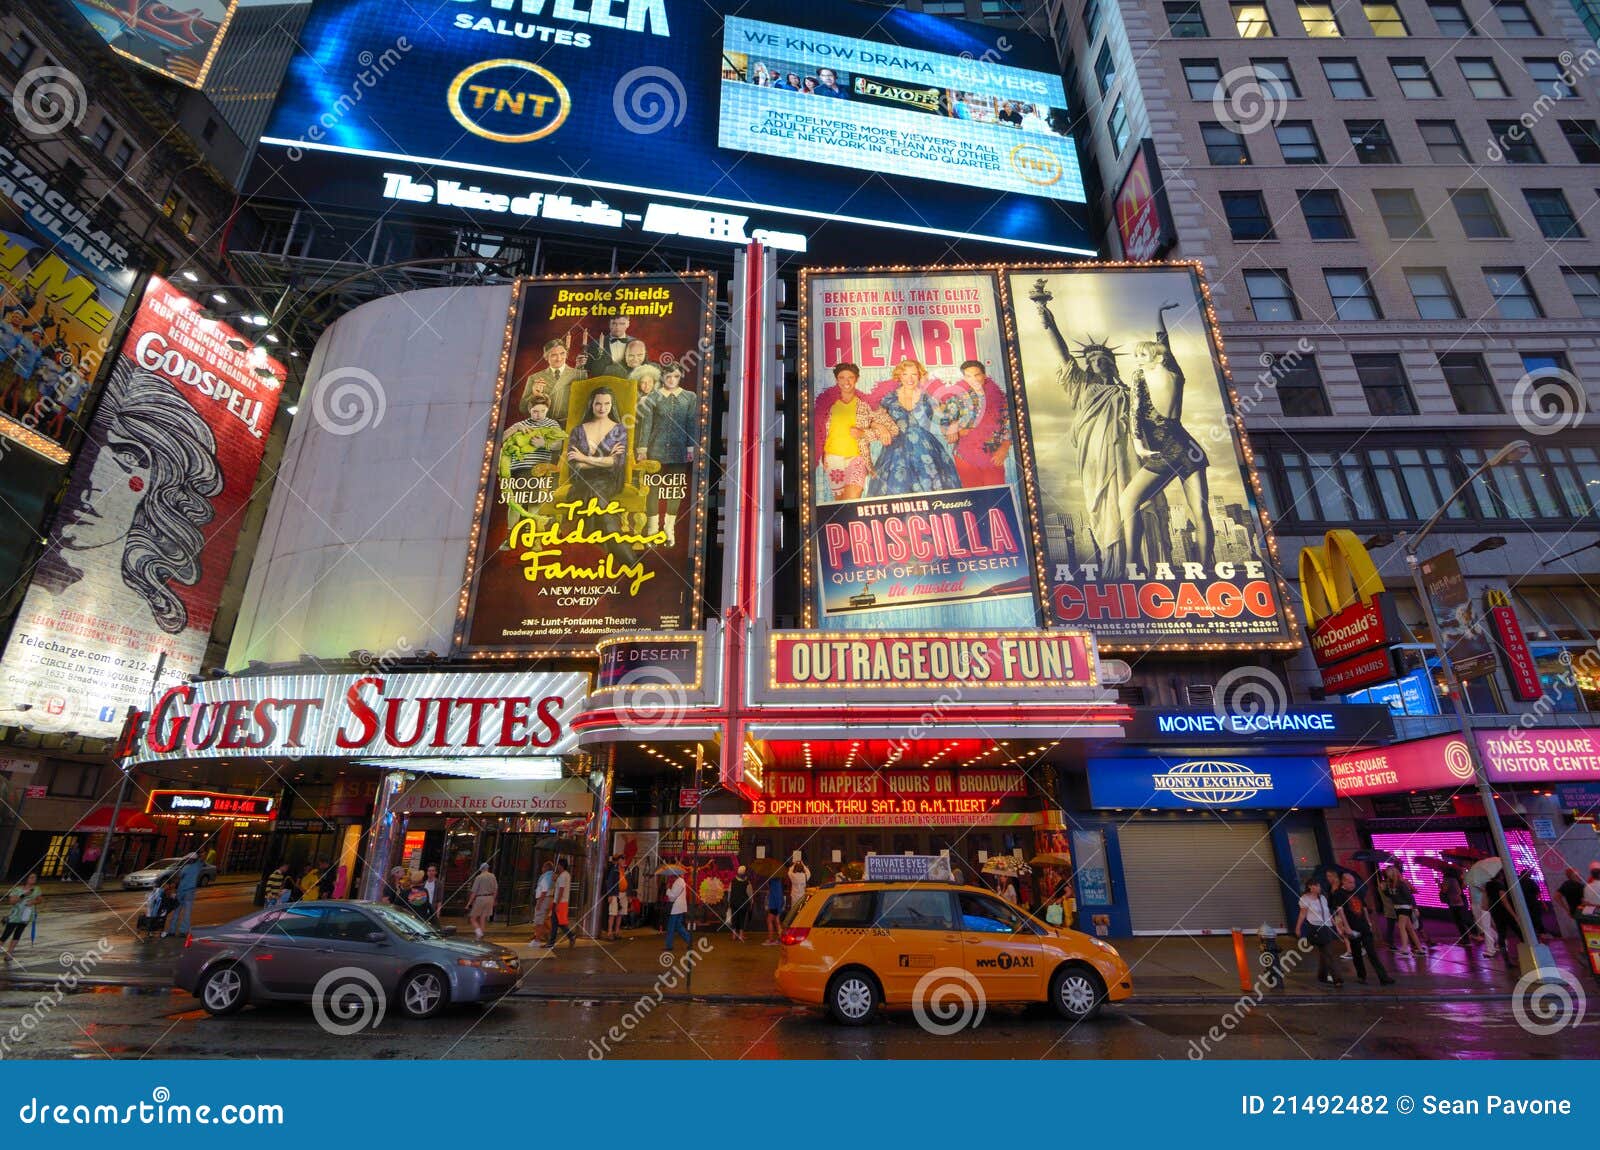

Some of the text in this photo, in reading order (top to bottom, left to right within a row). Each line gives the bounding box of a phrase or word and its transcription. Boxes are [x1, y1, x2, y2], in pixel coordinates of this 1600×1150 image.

[454, 13, 592, 48] SALUTES
[744, 30, 1049, 95] WE KNOW DRAMA DELIVERS
[469, 85, 554, 118] TNT
[867, 83, 940, 105] PLAYOFFS
[764, 118, 1000, 163] ADULT KEY DEMOS THAN ANY OTHER
[767, 110, 998, 155] TNT DELIVERS MORE VIEWERS IN ALL
[750, 125, 1001, 172] CABLE NETWORK IN SECOND QUARTER
[1016, 156, 1054, 173] TNT
[383, 173, 434, 203] The
[437, 180, 510, 212] Voice
[510, 191, 545, 216] of
[541, 194, 623, 228] Media
[558, 287, 669, 303] Brooke Shields
[883, 290, 904, 302] ALL
[909, 290, 940, 301] THAT
[944, 289, 979, 301] GLITZ
[550, 302, 673, 320] joins the family!
[825, 304, 981, 317] BEATS A GREAT BIG SEQUINED
[149, 298, 175, 323] FROM
[175, 315, 192, 334] THE
[191, 327, 235, 360] COMPOSER
[168, 326, 206, 358] RETURNS
[206, 350, 217, 365] TO
[136, 331, 263, 439] GODSPELL
[500, 476, 554, 490] BROOKE
[643, 473, 687, 488] ROGER
[498, 490, 555, 504] SHIELDS
[658, 486, 686, 500] REES
[556, 498, 625, 520] The
[857, 499, 973, 517] BETTE MIDLER Presents
[509, 518, 668, 550] Addams
[825, 508, 1018, 569] PRISCILLA
[520, 550, 655, 597] Family
[832, 556, 1019, 585] QUEEN OF THE DESERT
[1054, 560, 1265, 581] AT LARGE
[538, 585, 621, 596] A NEW MUSICAL
[887, 576, 968, 598] the musical
[556, 597, 600, 607] COMEDY
[1053, 581, 1277, 621] CHICAGO
[541, 616, 637, 627] Lunt-Fontanne Theatre
[502, 629, 534, 637] Broadway
[1312, 614, 1378, 650] McDonald's
[1325, 633, 1369, 657] Restaurant
[19, 633, 192, 683] Telecharge.com or 212-29-6200
[603, 649, 690, 664] THE DESERT
[791, 640, 1074, 682] OUTRAGEOUS FUN!
[40, 657, 73, 672] CIRCLE
[75, 664, 85, 674] IN
[88, 667, 105, 678] THE
[1355, 659, 1384, 675] HOURS
[147, 685, 323, 753] GUEST
[336, 677, 565, 749] SUITES
[1158, 714, 1335, 732] MONEY EXCHANGE
[1487, 738, 1594, 755] TIMES SQUARE
[1330, 756, 1388, 776] TIMES SQUARE
[1491, 755, 1600, 773] VISITOR CENTE
[779, 776, 805, 793] TWO
[820, 775, 878, 792] HAPPIEST
[890, 775, 931, 792] HOURS
[935, 775, 952, 792] ON
[959, 774, 1025, 792] BROADWAY!
[1154, 775, 1273, 788] MONEY EXCHANGE
[1334, 771, 1398, 790] VISITOR CENTER
[420, 796, 567, 810] DOUBLETREE GUEST SUITES
[752, 800, 766, 814] IS
[770, 800, 801, 813] OPEN
[895, 814, 915, 824] GREAT
[870, 858, 927, 868] PRIVATE EYES
[976, 959, 997, 967] NYC
